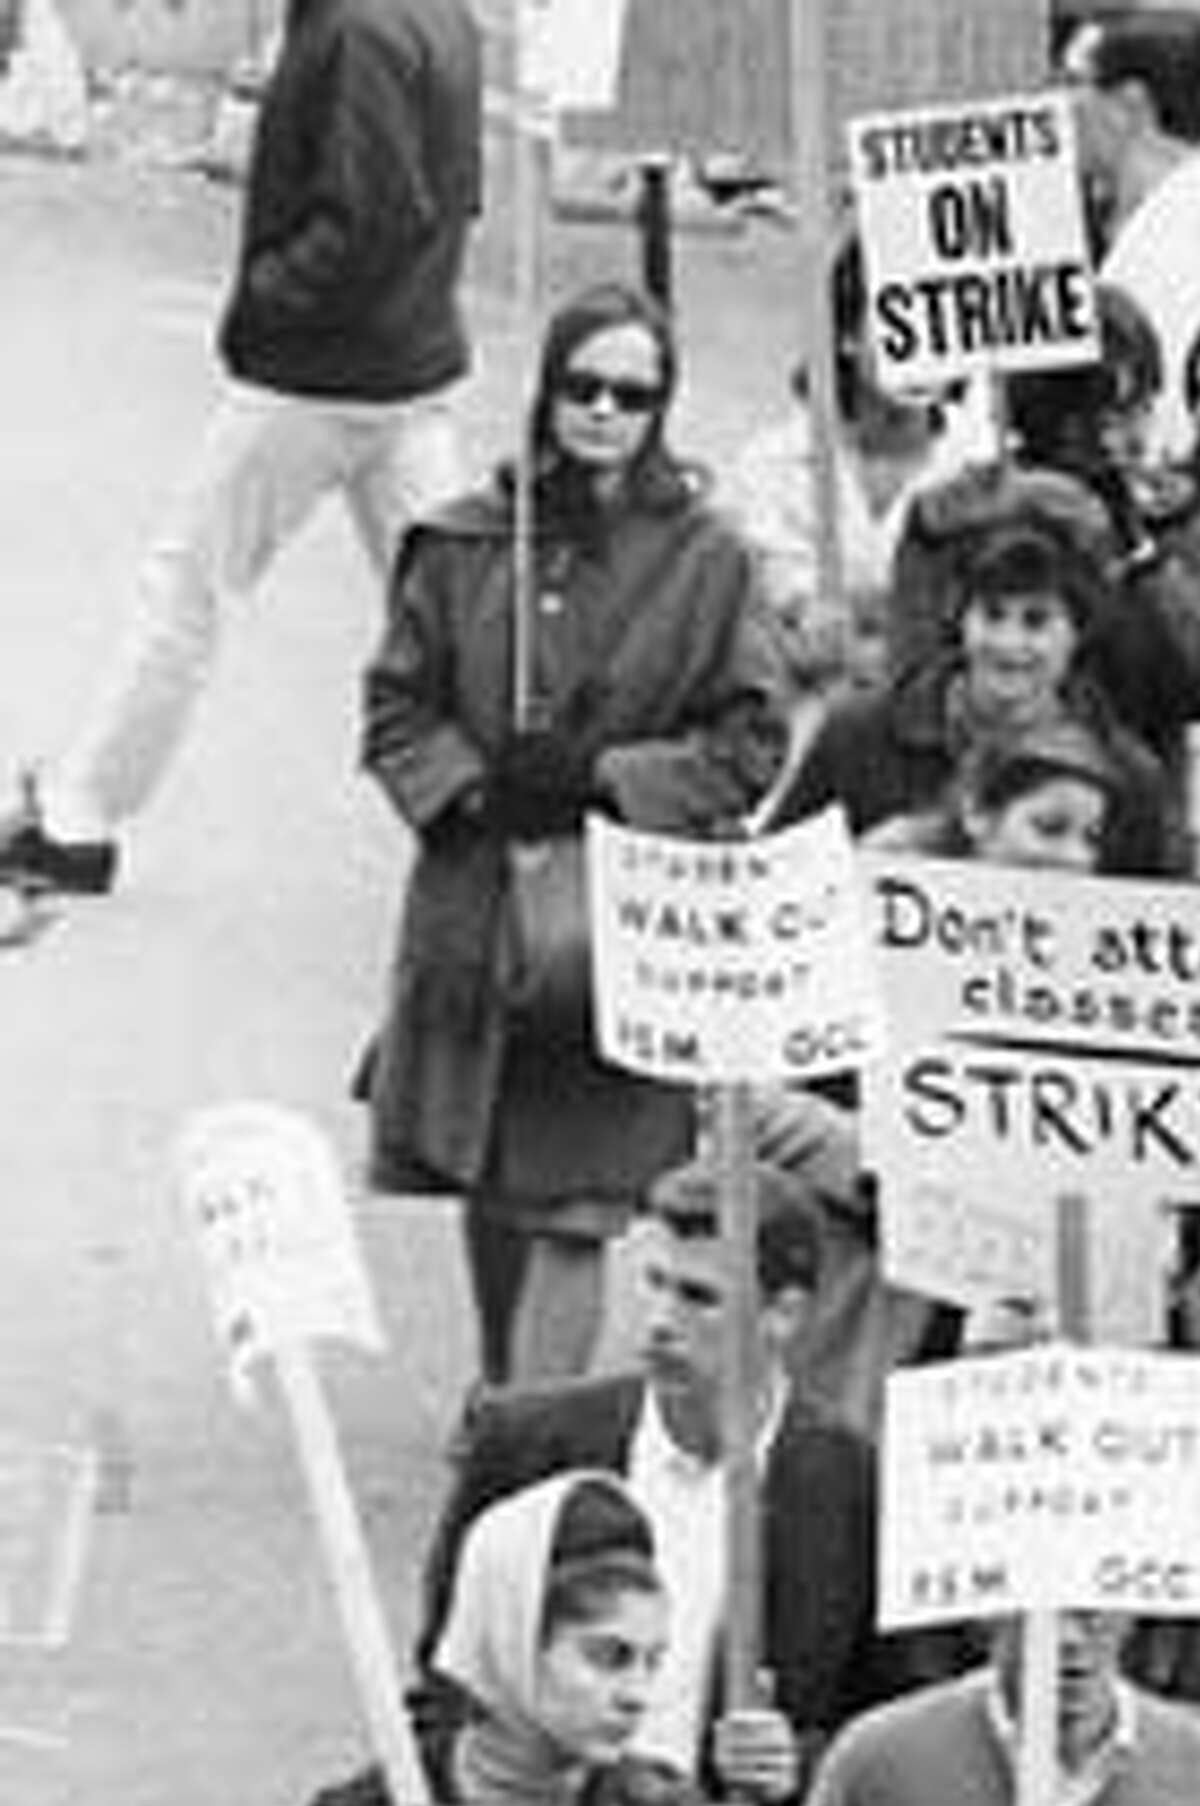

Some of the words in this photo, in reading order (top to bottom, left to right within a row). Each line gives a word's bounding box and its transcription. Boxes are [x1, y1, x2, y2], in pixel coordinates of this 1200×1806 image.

[860, 110, 1059, 181] STUDENTS
[929, 174, 1014, 260] ON
[876, 264, 1089, 362] STRIKE
[617, 897, 750, 945] WALK
[873, 877, 1054, 970] Don't
[926, 1419, 1070, 1466] WALK
